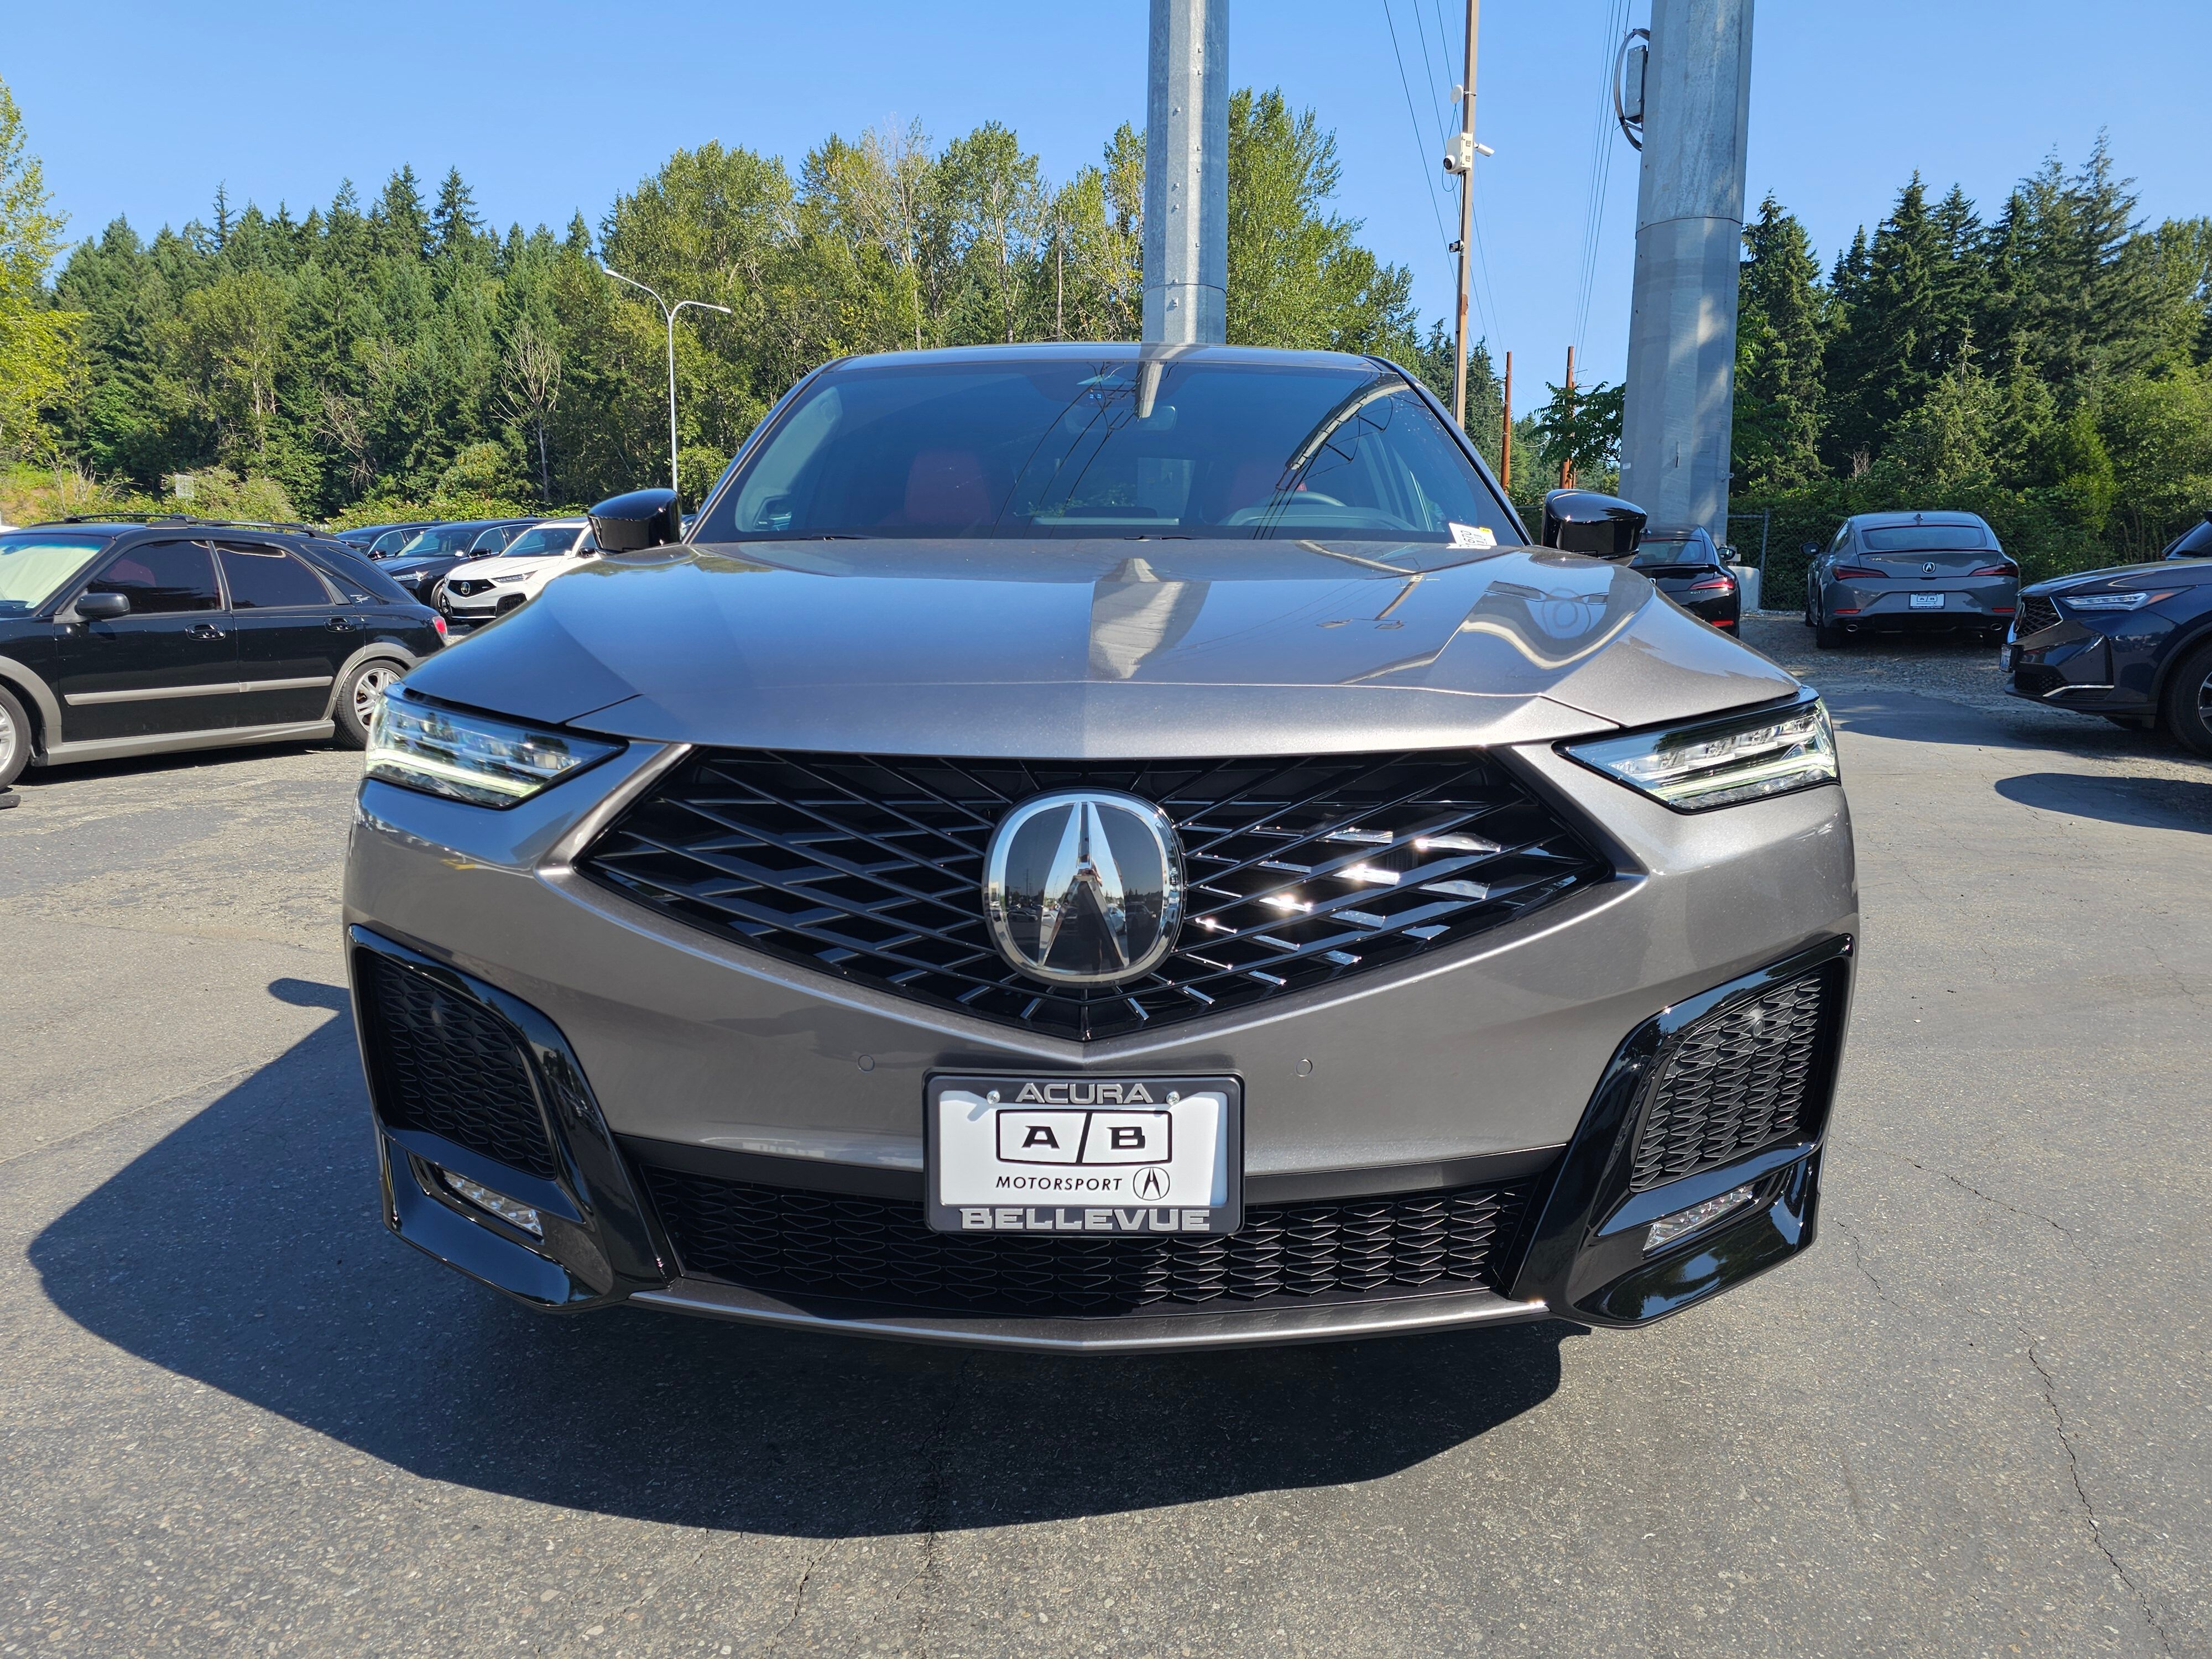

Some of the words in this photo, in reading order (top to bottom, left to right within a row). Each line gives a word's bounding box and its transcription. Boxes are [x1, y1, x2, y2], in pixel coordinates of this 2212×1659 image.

[1015, 1082, 1154, 1104] ACURA
[1021, 1125, 1060, 1150] A
[1107, 1126, 1146, 1150] B
[995, 1176, 1123, 1191] MOTORSPORT
[959, 1207, 1210, 1232] BELLEVUE
